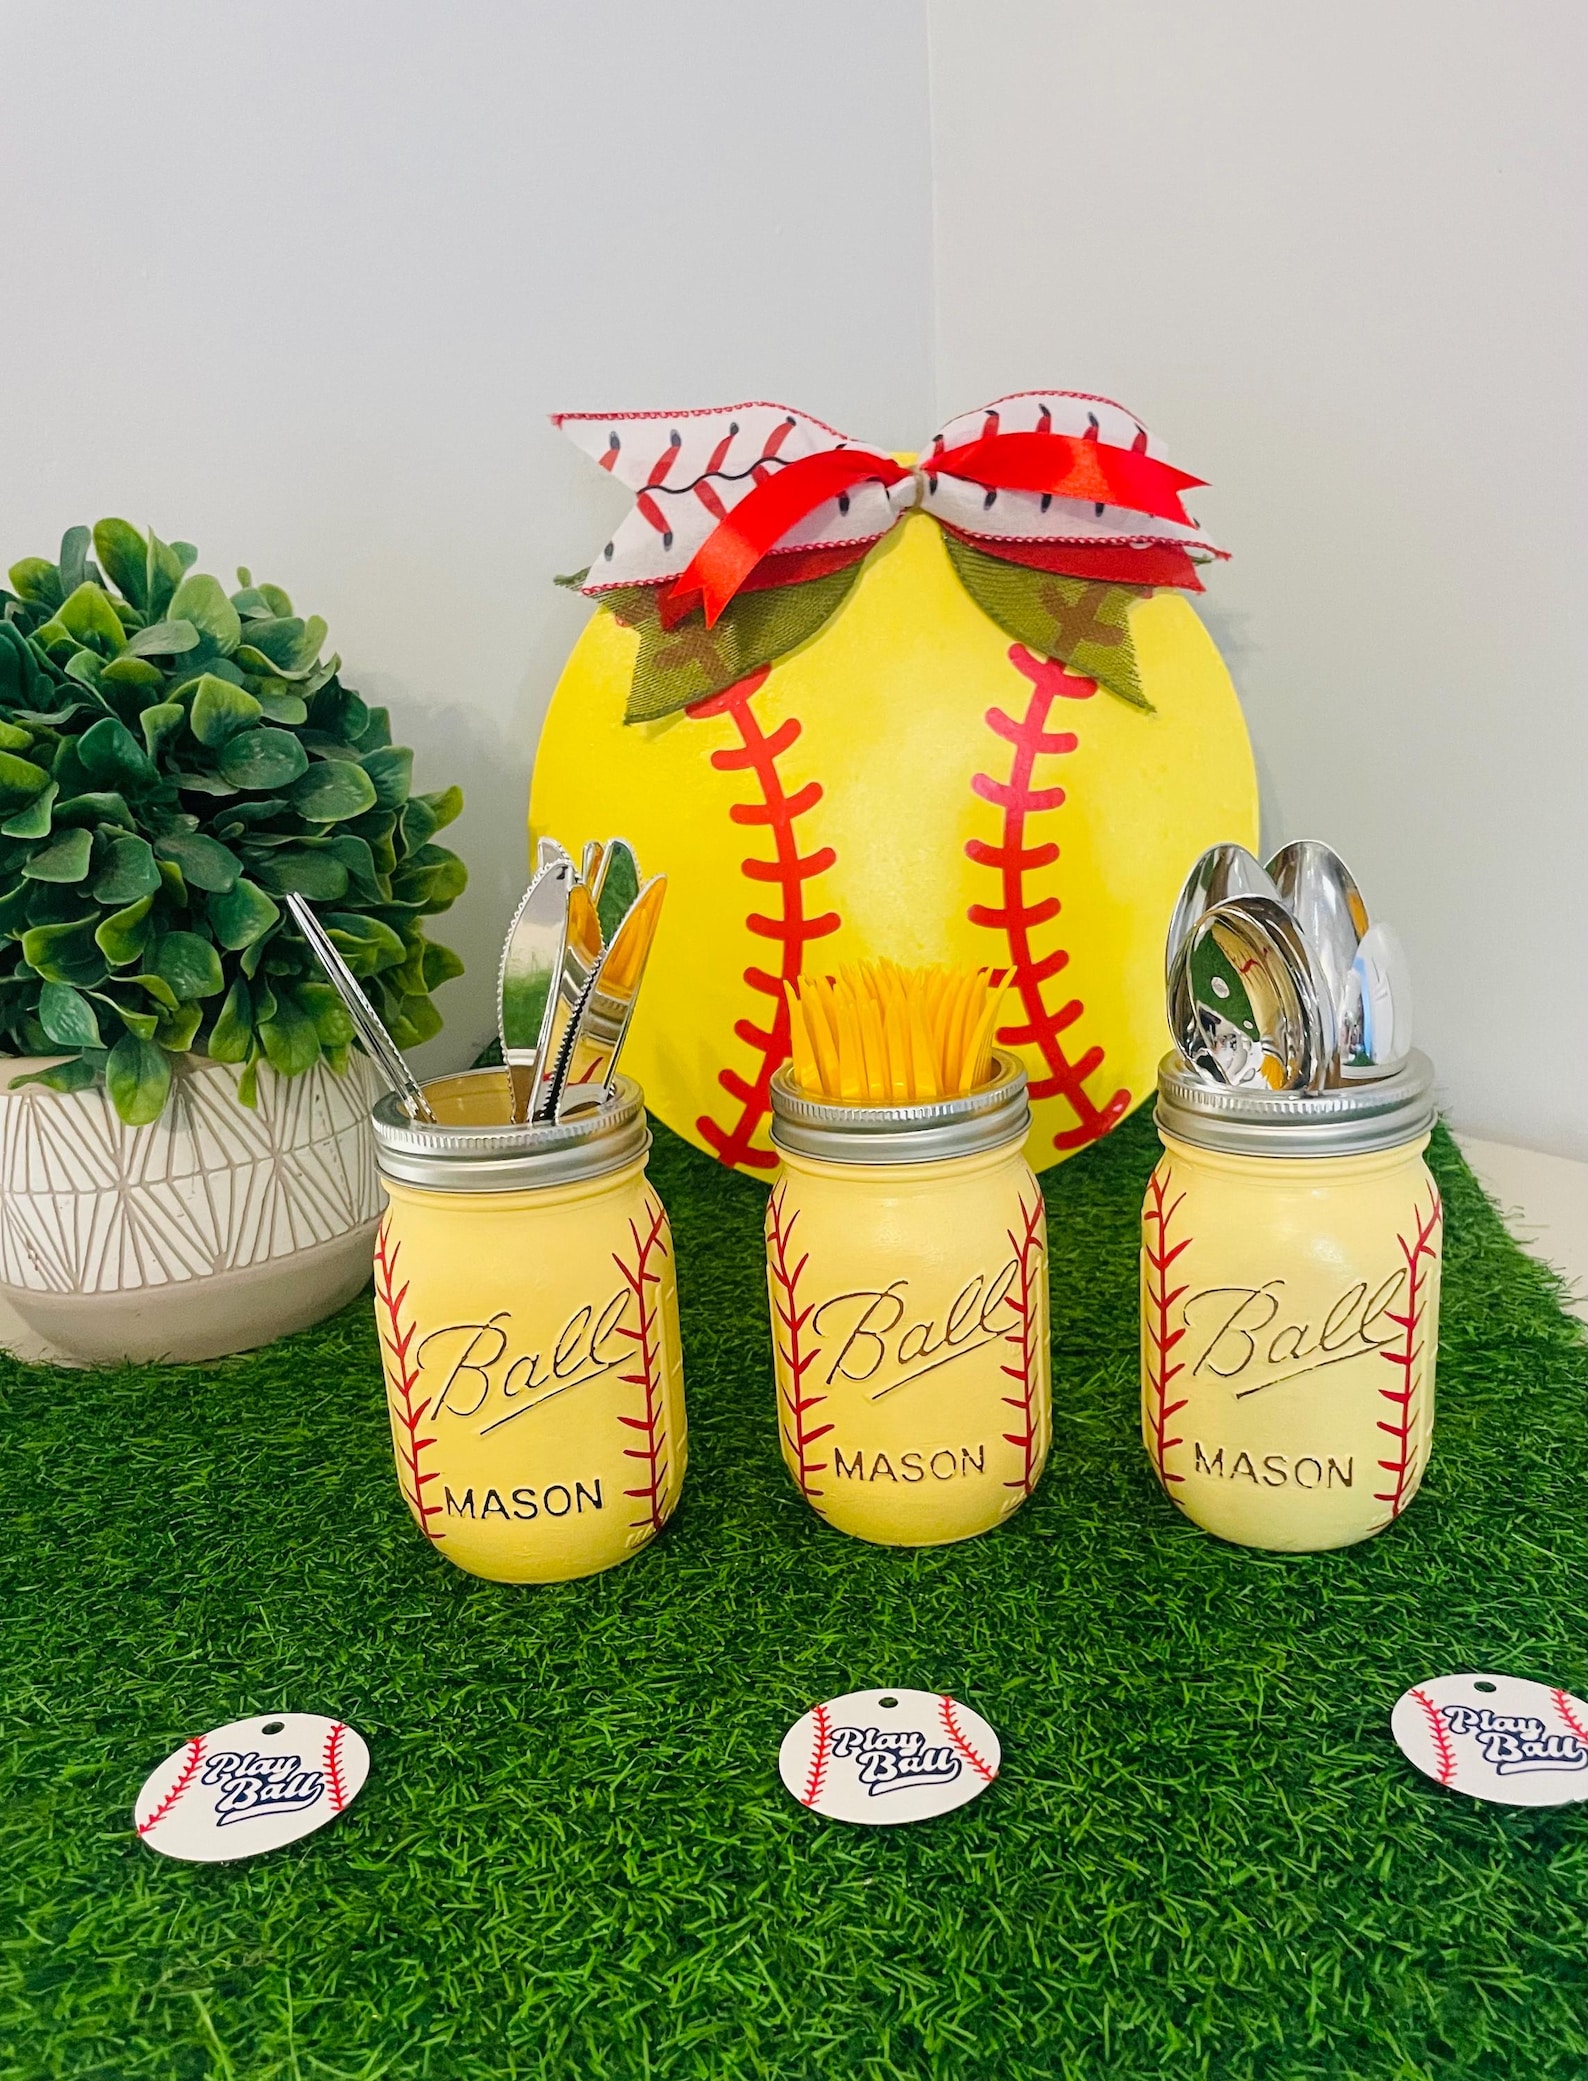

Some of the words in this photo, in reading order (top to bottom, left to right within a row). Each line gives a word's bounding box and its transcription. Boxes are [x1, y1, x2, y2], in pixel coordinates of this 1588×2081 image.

[811, 1258, 1021, 1385] Ball
[1182, 1267, 1408, 1377] Ball
[415, 1287, 638, 1421] Ball
[834, 1444, 985, 1483] MASON
[1195, 1441, 1353, 1489] MASON
[444, 1478, 604, 1521] MASON
[828, 1726, 926, 1757] Play
[1441, 1704, 1546, 1741] Play
[201, 1751, 302, 1786] Play
[855, 1747, 962, 1784] Ball
[1475, 1730, 1588, 1769] Ball
[214, 1771, 325, 1815] Ball
